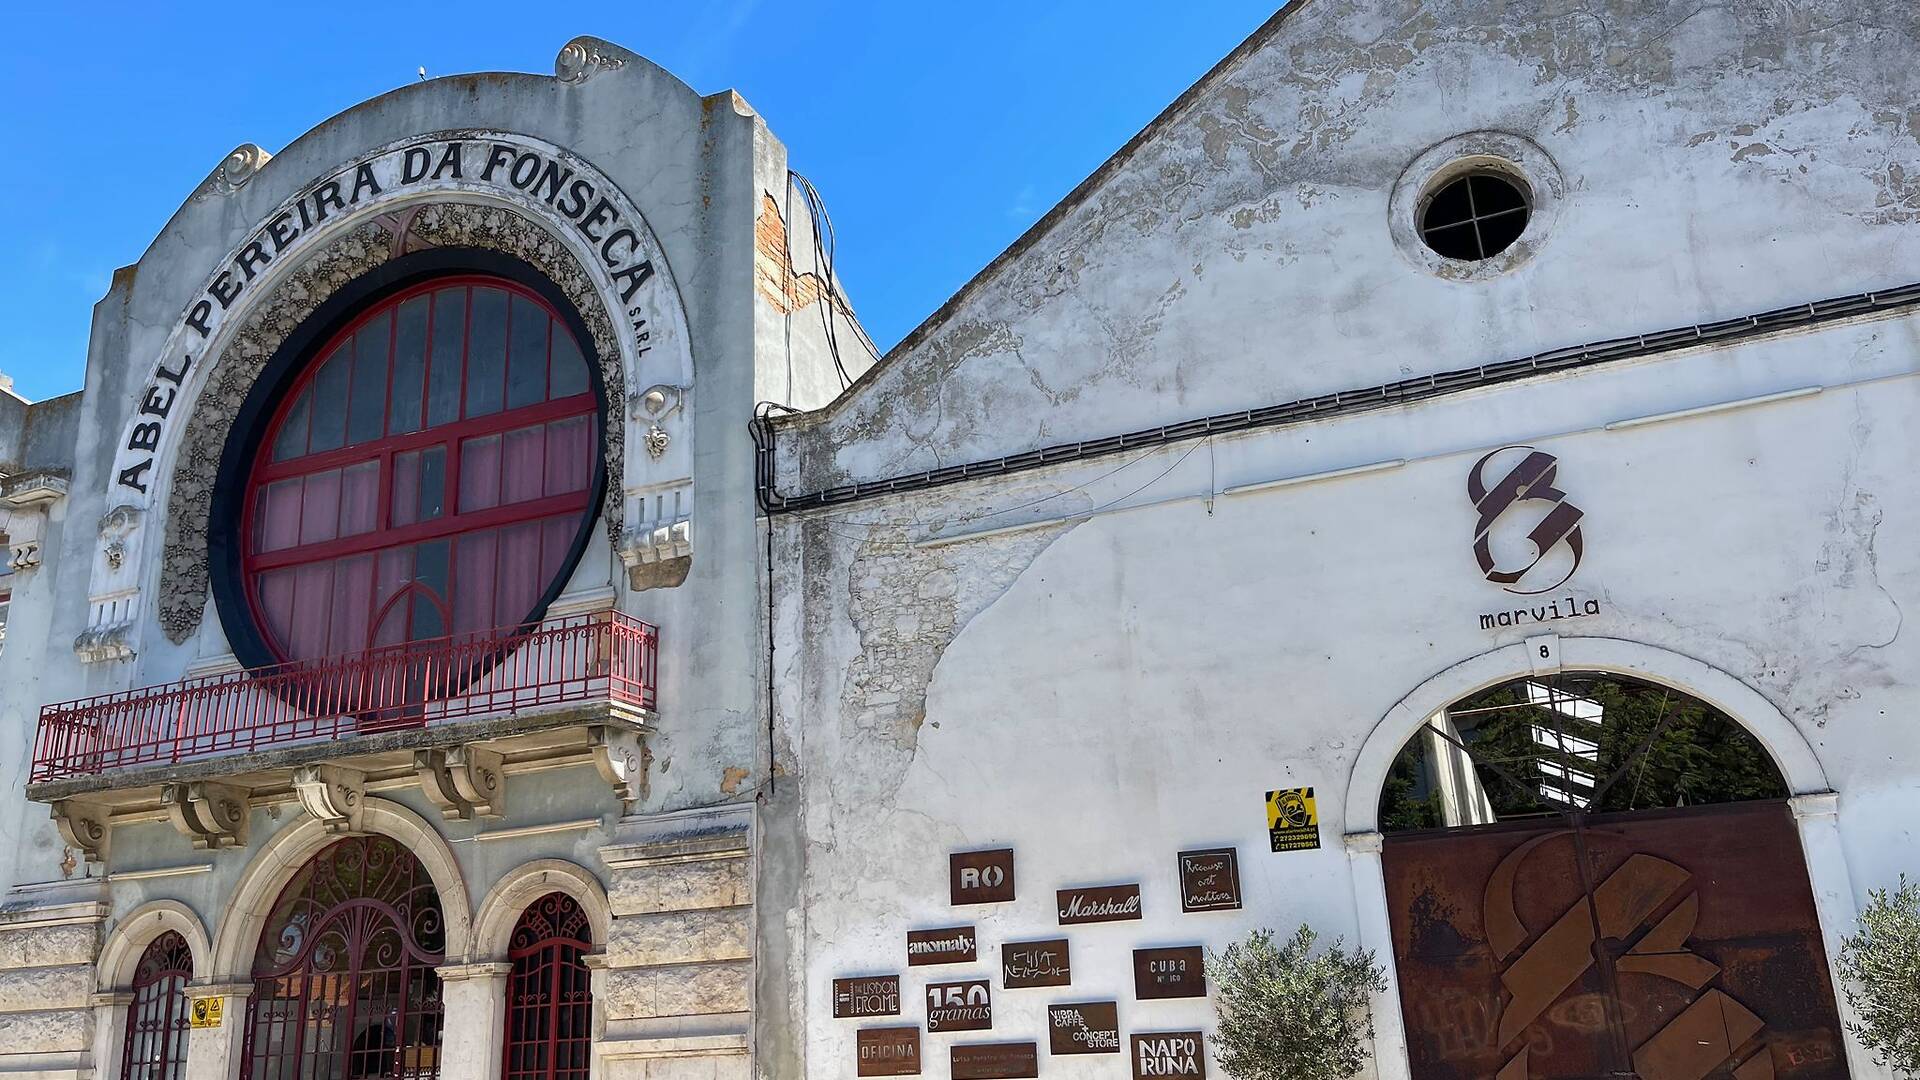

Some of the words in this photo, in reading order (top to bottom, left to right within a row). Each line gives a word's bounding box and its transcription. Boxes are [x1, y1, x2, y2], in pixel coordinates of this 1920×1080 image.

[118, 354, 192, 493] ABEL
[186, 163, 382, 340] PEREIRA
[401, 142, 463, 186] DA
[480, 144, 655, 304] FONSECA
[1479, 597, 1601, 630] marvila
[1539, 645, 1550, 659] 8
[960, 865, 1004, 889] RO
[1060, 894, 1140, 918] Marshall
[928, 985, 989, 1008] 150
[928, 1005, 991, 1029] gramas
[1050, 1009, 1080, 1020] VIBRA
[1072, 1030, 1117, 1042] CONCEPT
[1087, 1038, 1119, 1048] STORE
[861, 1044, 914, 1059] OFICINA
[1138, 1038, 1195, 1058] NAPO
[1140, 1056, 1199, 1076] RUNA
